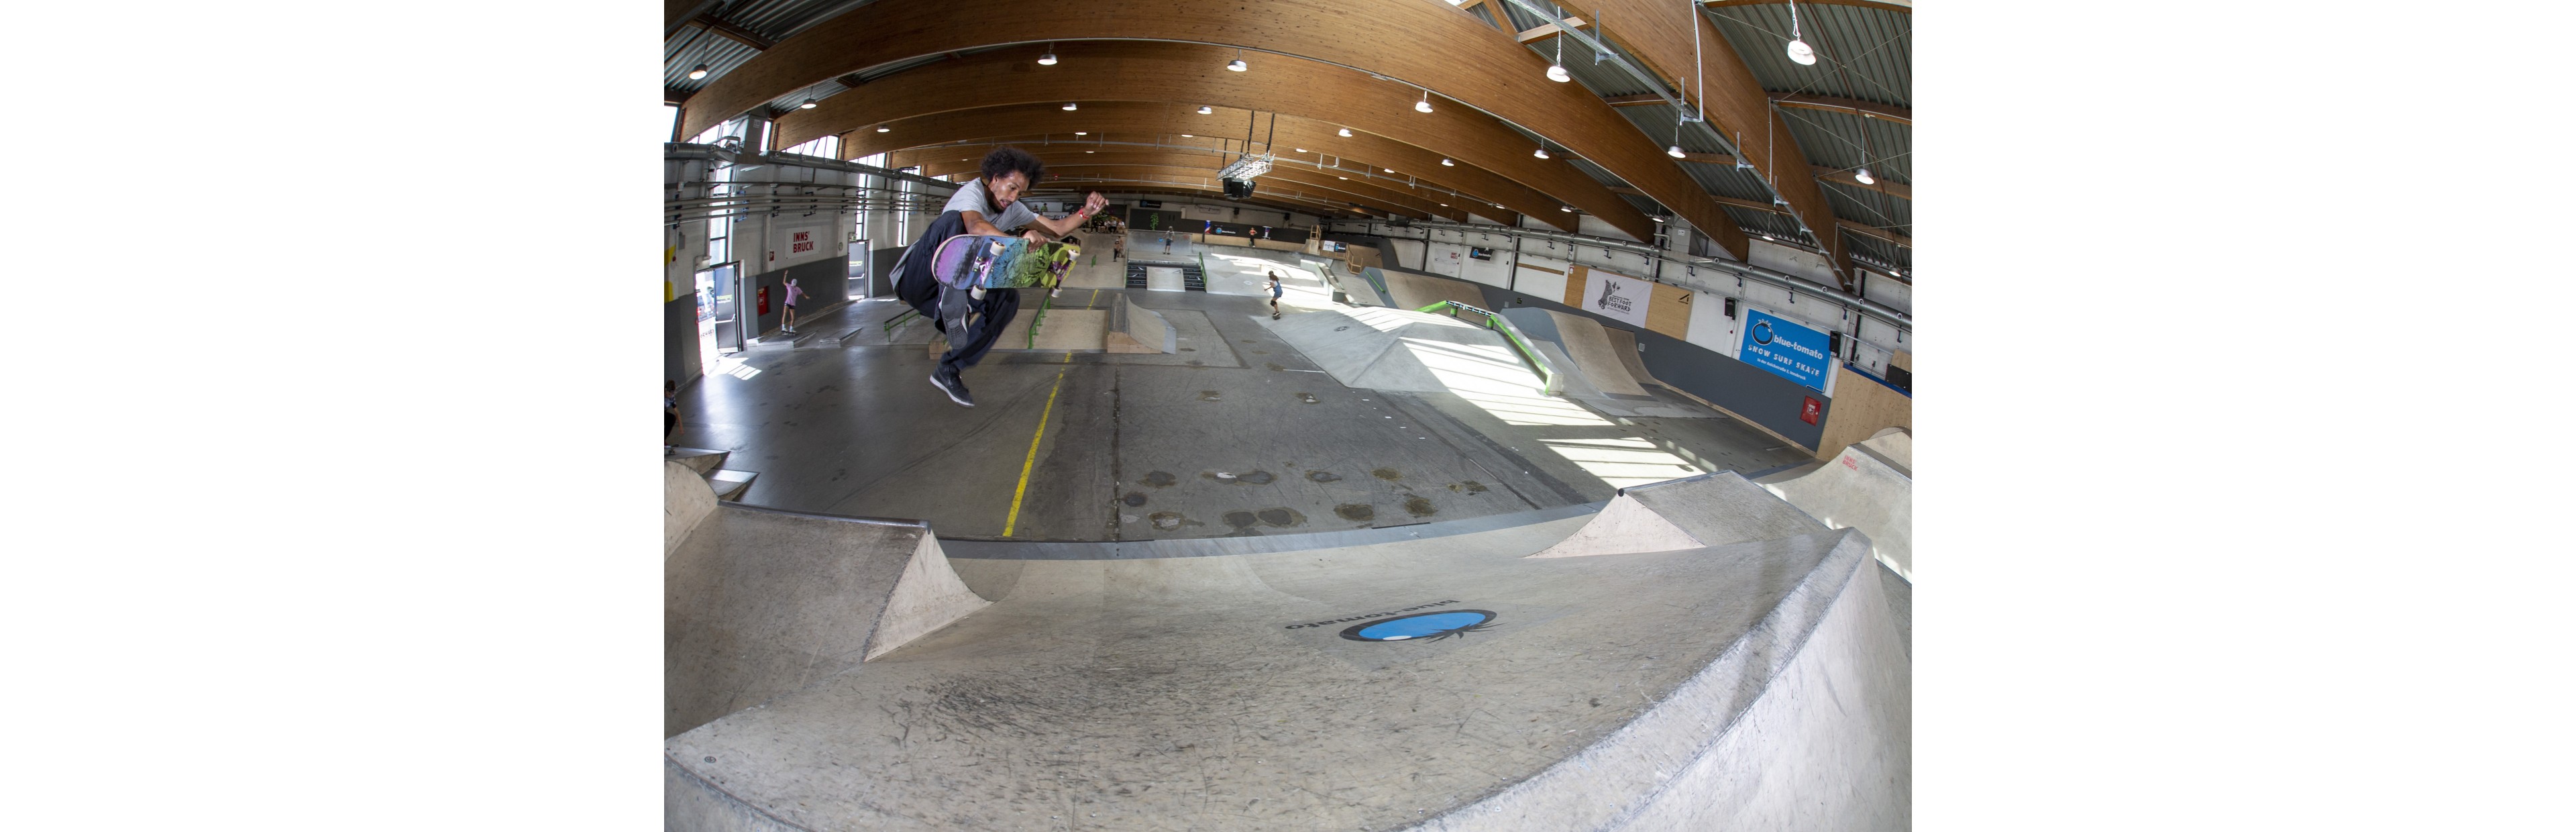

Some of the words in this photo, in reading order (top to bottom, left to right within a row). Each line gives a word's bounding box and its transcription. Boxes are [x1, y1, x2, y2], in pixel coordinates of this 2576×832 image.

[793, 241, 814, 253] BRUCK
[1607, 302, 1631, 311] FORWARD
[1774, 335, 1823, 360] blue-tomato
[1748, 344, 1771, 357] SNOW
[1773, 354, 1793, 366] SURF
[1796, 362, 1820, 376] SKATE
[1843, 460, 1858, 470] BRUCK
[1284, 599, 1461, 629] blue-tomato
